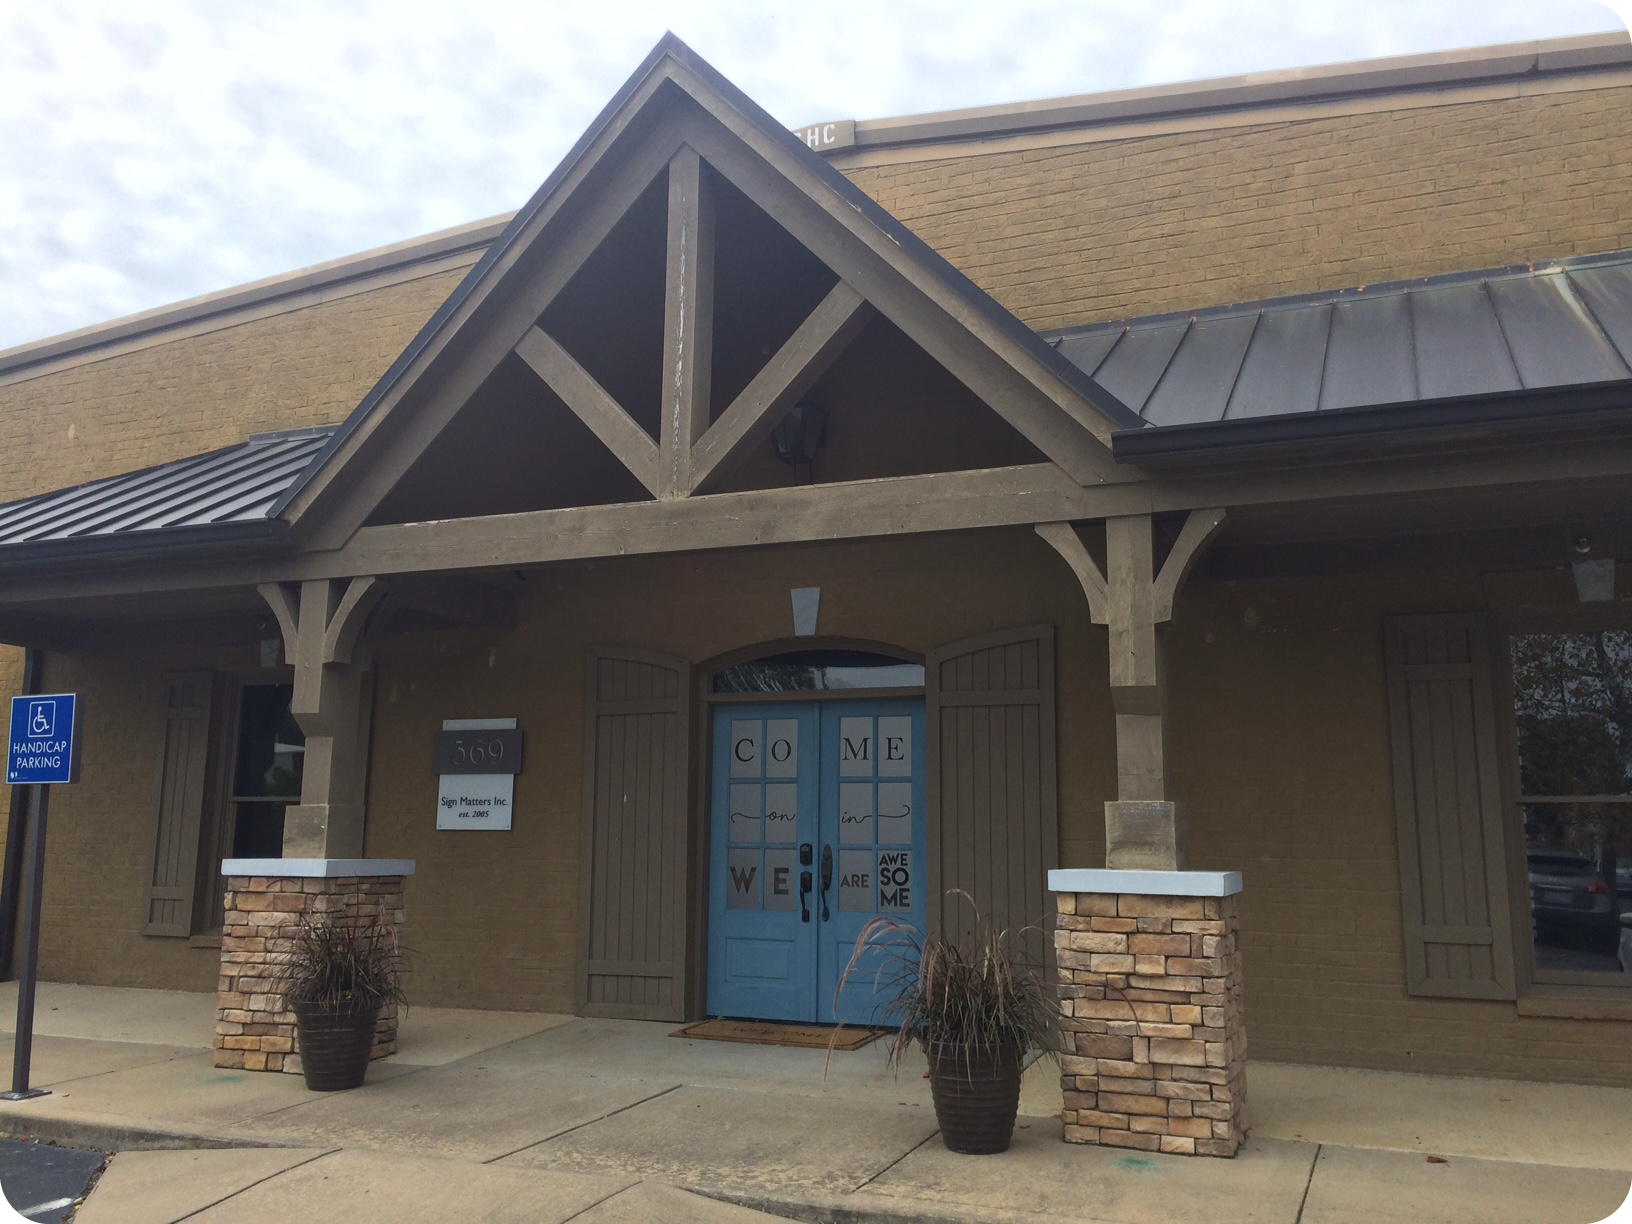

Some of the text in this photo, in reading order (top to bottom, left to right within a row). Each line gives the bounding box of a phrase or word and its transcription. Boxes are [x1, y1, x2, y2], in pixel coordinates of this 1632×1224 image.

[794, 124, 835, 148] HC
[13, 740, 67, 754] HANDICAP
[451, 739, 504, 765] 369
[16, 756, 61, 768] PARKING
[441, 796, 509, 808] Sign Matters Inc.
[472, 810, 489, 818] 2005
[879, 852, 909, 867] AWE
[729, 866, 870, 896] WE ARE
[880, 867, 910, 887] SO
[880, 887, 911, 908] ME
